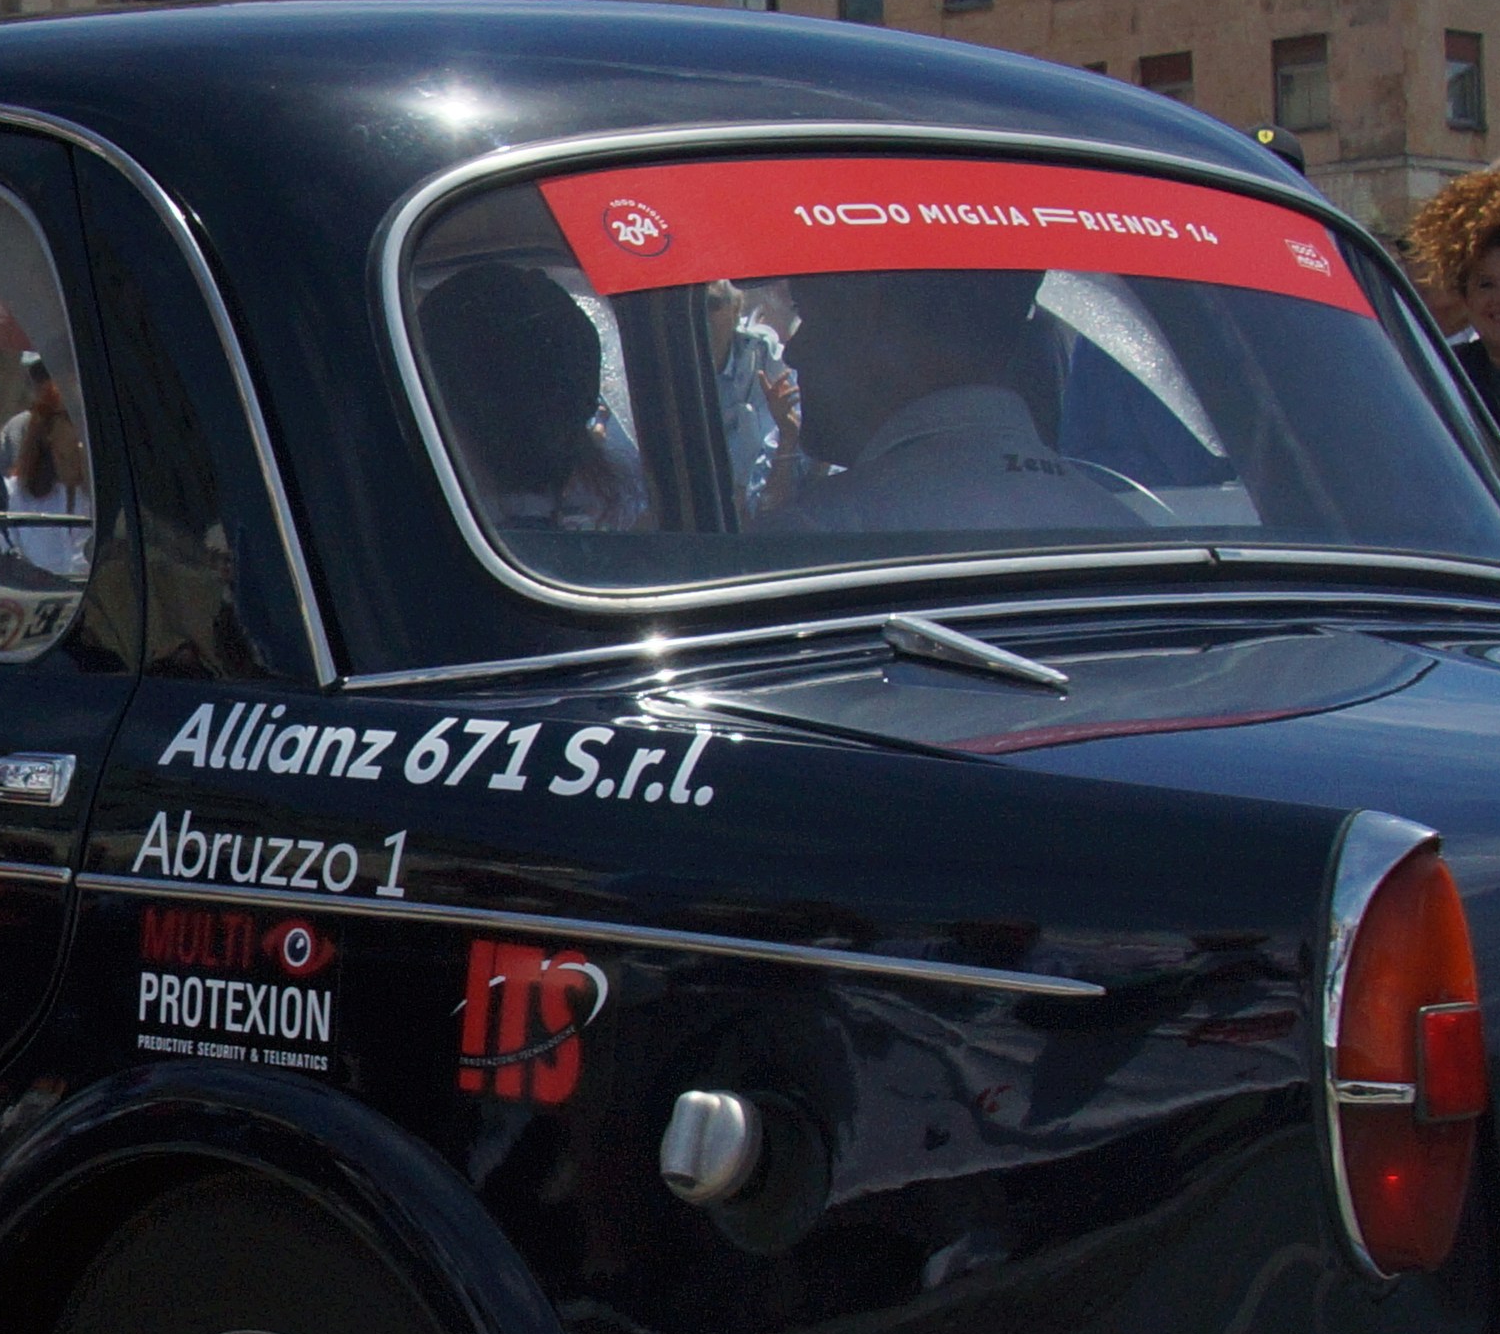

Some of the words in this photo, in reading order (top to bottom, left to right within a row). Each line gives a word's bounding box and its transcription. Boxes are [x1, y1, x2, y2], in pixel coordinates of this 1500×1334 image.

[918, 203, 1031, 228] MIGLIA
[1188, 222, 1219, 246] 14
[158, 702, 397, 780] Allianz
[403, 717, 542, 791] 671
[548, 723, 716, 806] S.r.l.
[131, 810, 359, 894] Abruzzo
[375, 830, 407, 898] 1
[138, 971, 332, 1043] PROTEXION
[138, 1034, 193, 1056] PREDICTIVE
[197, 1041, 246, 1061] SECURITY
[250, 1048, 258, 1063] &
[262, 1049, 328, 1071] TELEMATICS
